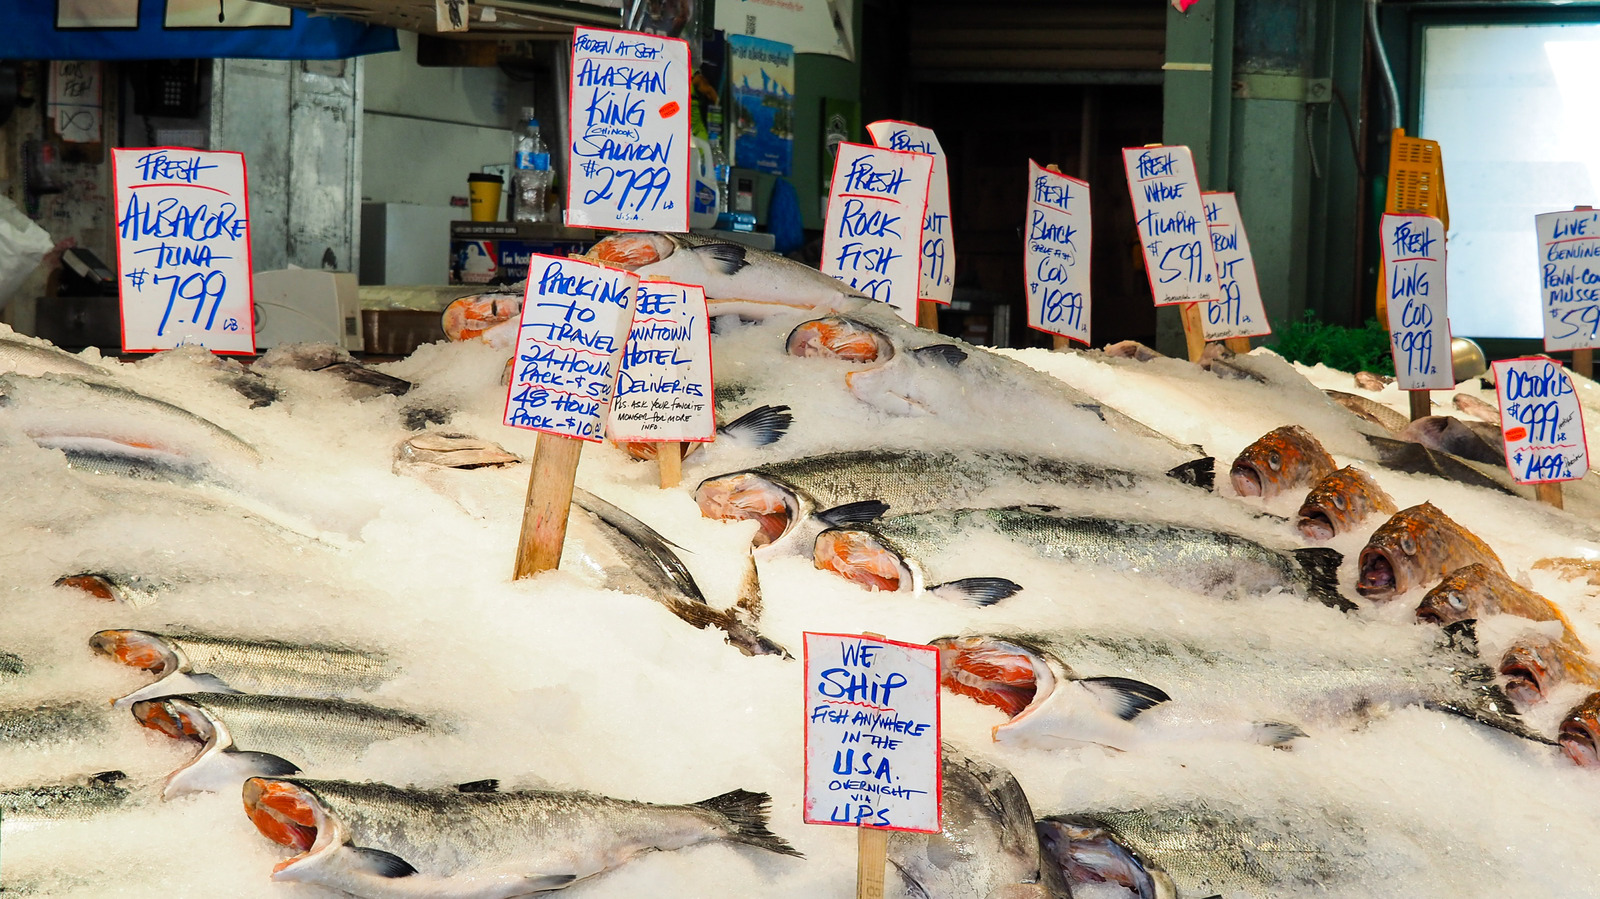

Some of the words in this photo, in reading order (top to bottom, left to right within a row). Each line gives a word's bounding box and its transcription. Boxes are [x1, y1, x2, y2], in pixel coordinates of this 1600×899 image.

[574, 34, 614, 55] FROZEN
[615, 41, 635, 56] AT
[577, 58, 671, 95] ALASKAN
[585, 87, 645, 127] KING
[573, 133, 673, 164] SALMON
[135, 150, 218, 183] FRESH
[844, 154, 911, 196] FRESH
[1136, 151, 1178, 179] FRESH
[1035, 175, 1075, 210] FRESH
[1144, 181, 1188, 203] WHOLE
[118, 191, 248, 241] ALBACORE
[839, 198, 902, 240] ROCK
[1031, 209, 1077, 252] BLACK
[1137, 209, 1200, 236] TILAPIA
[1210, 223, 1238, 252] BOW
[1392, 221, 1436, 257] FRESH
[1547, 242, 1600, 262] GENUINE
[133, 242, 233, 269] TUNA
[835, 242, 903, 276] FISH
[538, 261, 632, 309] PACKING
[1037, 256, 1068, 285] COD
[1392, 263, 1429, 300] LING
[1548, 286, 1600, 306] MUSSE
[537, 300, 595, 323] TO
[1402, 298, 1432, 329] COD
[521, 323, 619, 354] TRAVEL
[629, 316, 695, 341] WNTOWN
[554, 352, 613, 378] HOUR
[623, 341, 692, 370] HOTEL
[613, 370, 704, 397] DELIVERIES
[1506, 362, 1574, 401] OCTOPUS
[512, 386, 549, 409] 48
[551, 393, 600, 418] HOUR
[631, 400, 648, 410] ASK
[650, 398, 670, 411] YOUR
[667, 414, 692, 423] MORE
[841, 639, 883, 667] WE
[818, 667, 908, 706] SHIP
[811, 705, 850, 725] FISH
[851, 710, 931, 737] ANYWHERE
[841, 731, 861, 744] IN
[862, 733, 903, 750] THE
[832, 748, 900, 784] U.S.A.
[829, 779, 928, 800] OVERNIGHT
[851, 794, 871, 804] VIA
[831, 803, 891, 827] UPS
